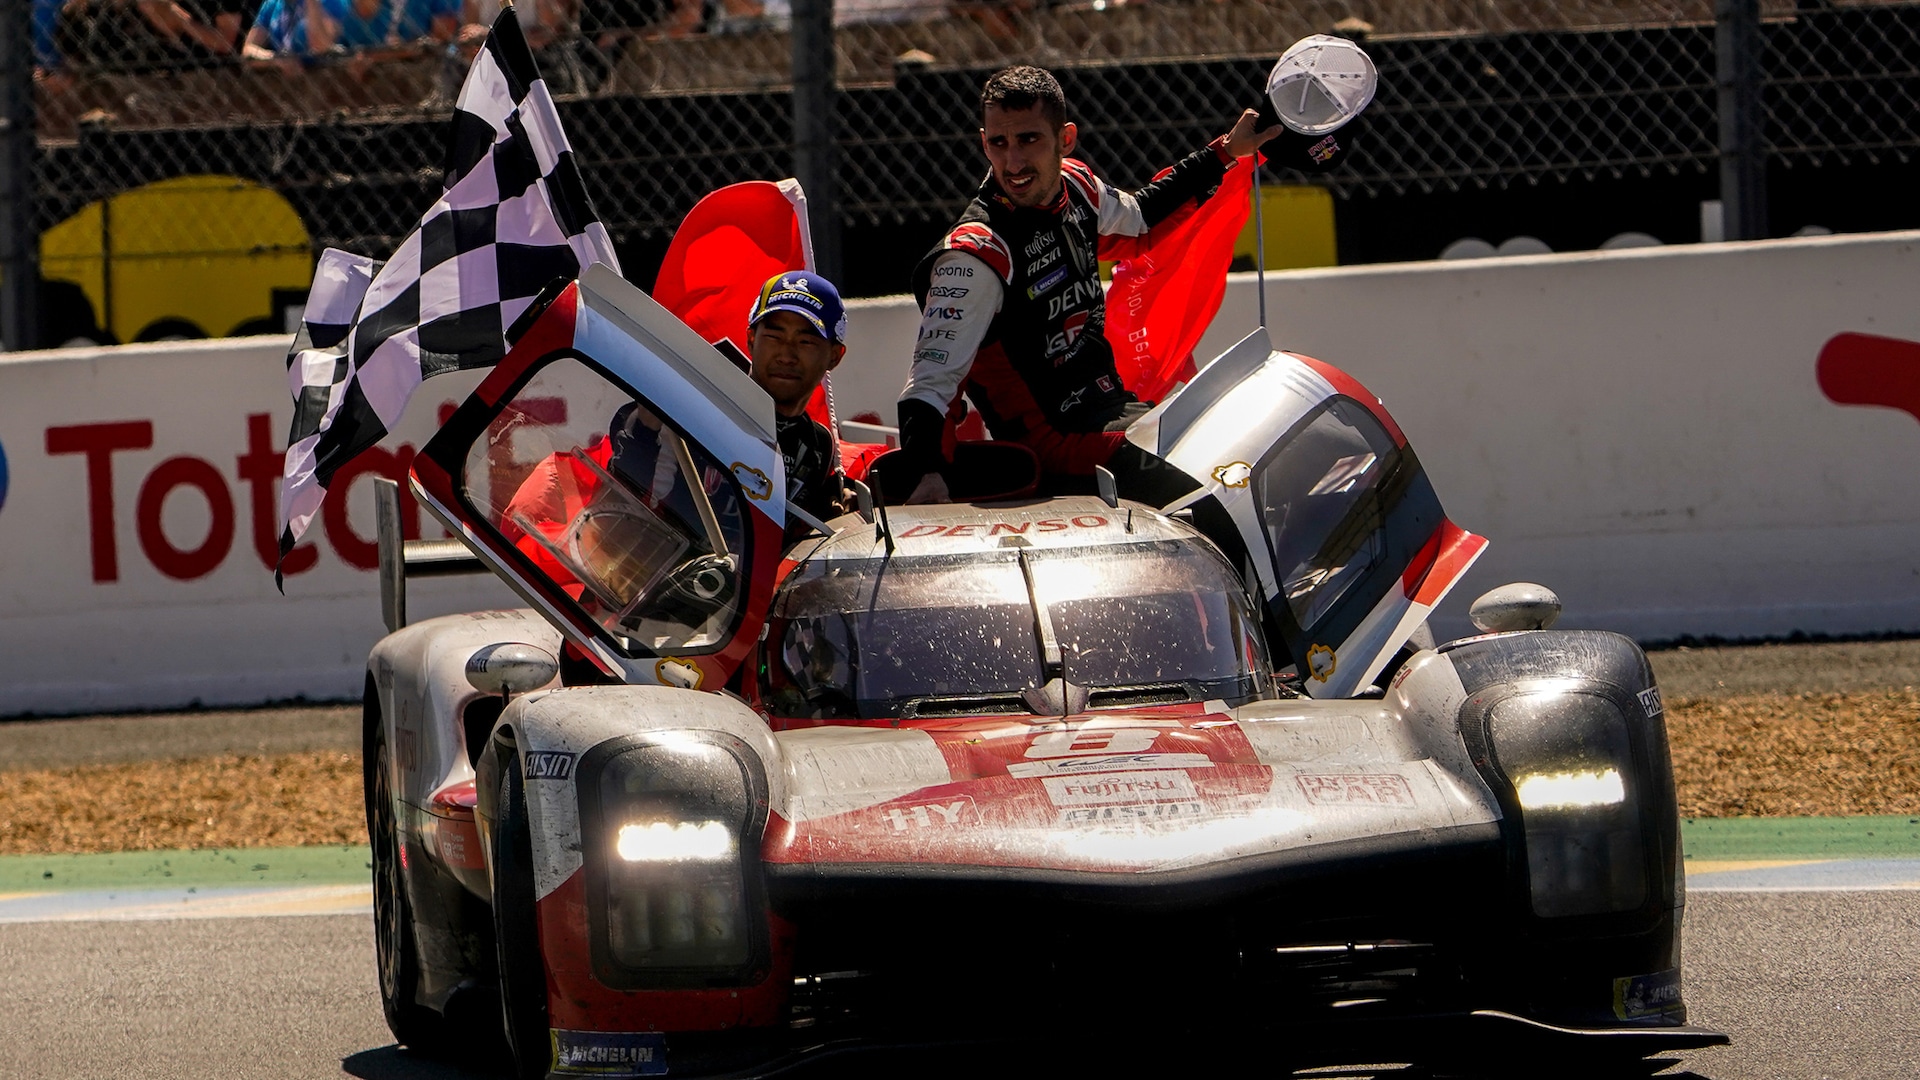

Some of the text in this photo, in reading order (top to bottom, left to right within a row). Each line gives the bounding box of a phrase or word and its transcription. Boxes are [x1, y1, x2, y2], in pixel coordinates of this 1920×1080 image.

[1024, 230, 1056, 259] FUJITSU
[1027, 246, 1062, 277] AISIN
[768, 292, 824, 310] MICHELIN
[930, 287, 969, 298] RAYS
[924, 329, 958, 341] JFE
[897, 515, 1109, 539] DENSO
[1023, 729, 1161, 759] 8
[526, 753, 572, 777] AISIN
[1064, 779, 1177, 797] FUJITSU
[1303, 776, 1398, 786] HYPER
[1311, 785, 1407, 804] CAR
[570, 1045, 654, 1063] MICHELIN
